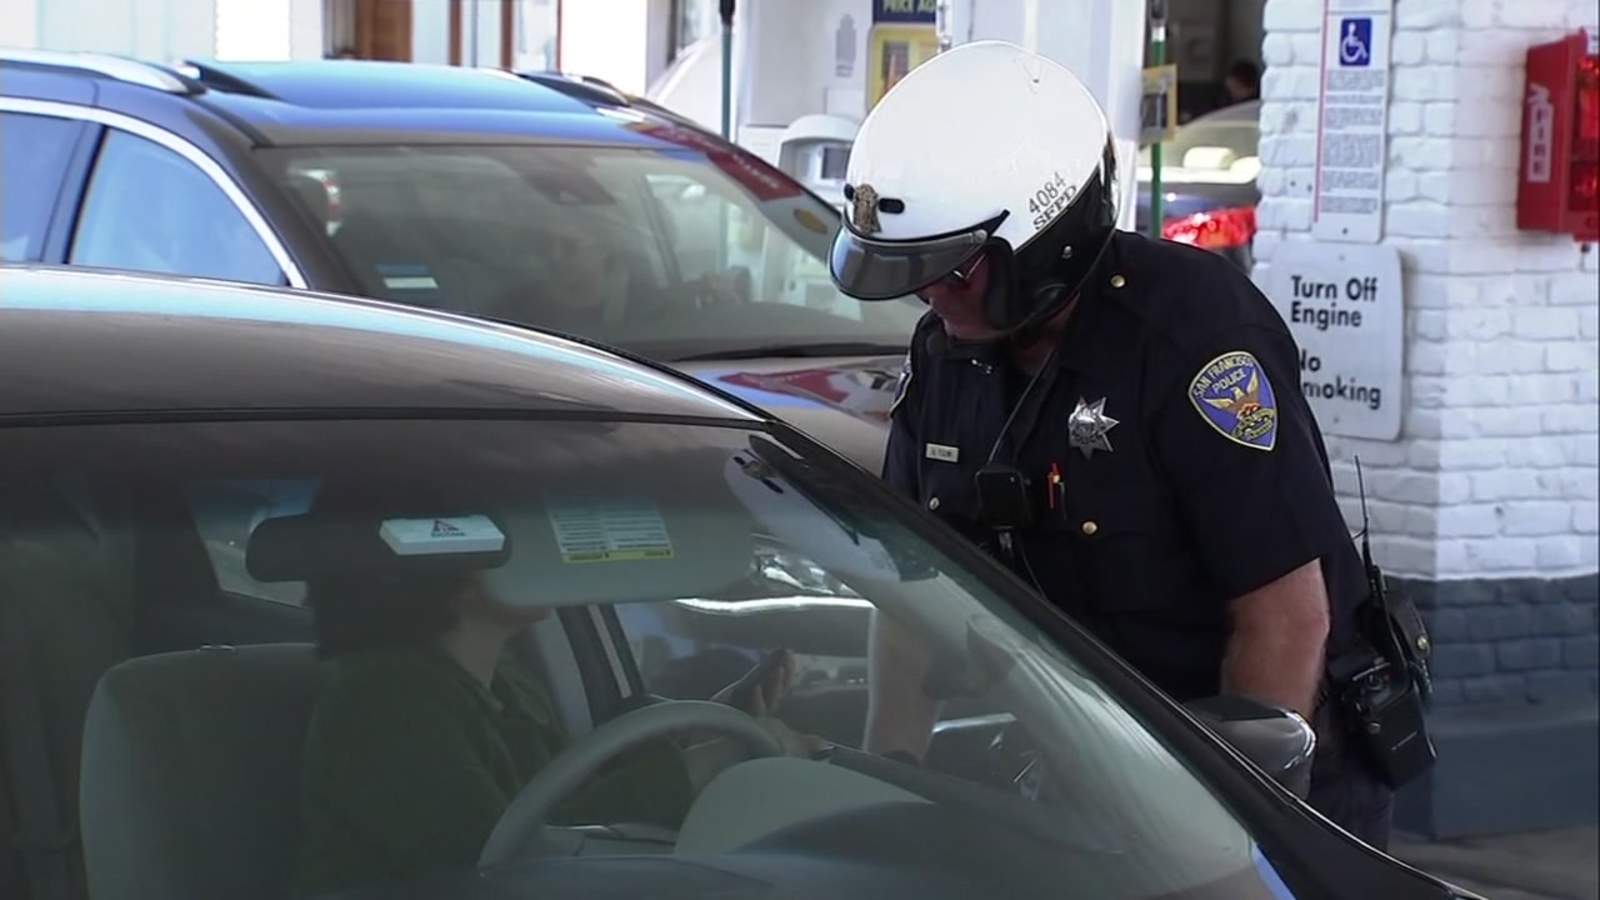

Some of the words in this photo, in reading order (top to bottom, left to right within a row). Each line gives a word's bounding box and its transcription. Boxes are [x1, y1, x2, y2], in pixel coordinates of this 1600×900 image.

[1029, 171, 1066, 213] 4084
[1033, 185, 1077, 230] SFPD
[1290, 275, 1338, 300] Turn
[1346, 277, 1378, 302] Off
[1290, 301, 1363, 331] Engine
[1193, 376, 1212, 397] SAN
[1212, 368, 1246, 394] POLICE
[1302, 375, 1381, 410] moking
